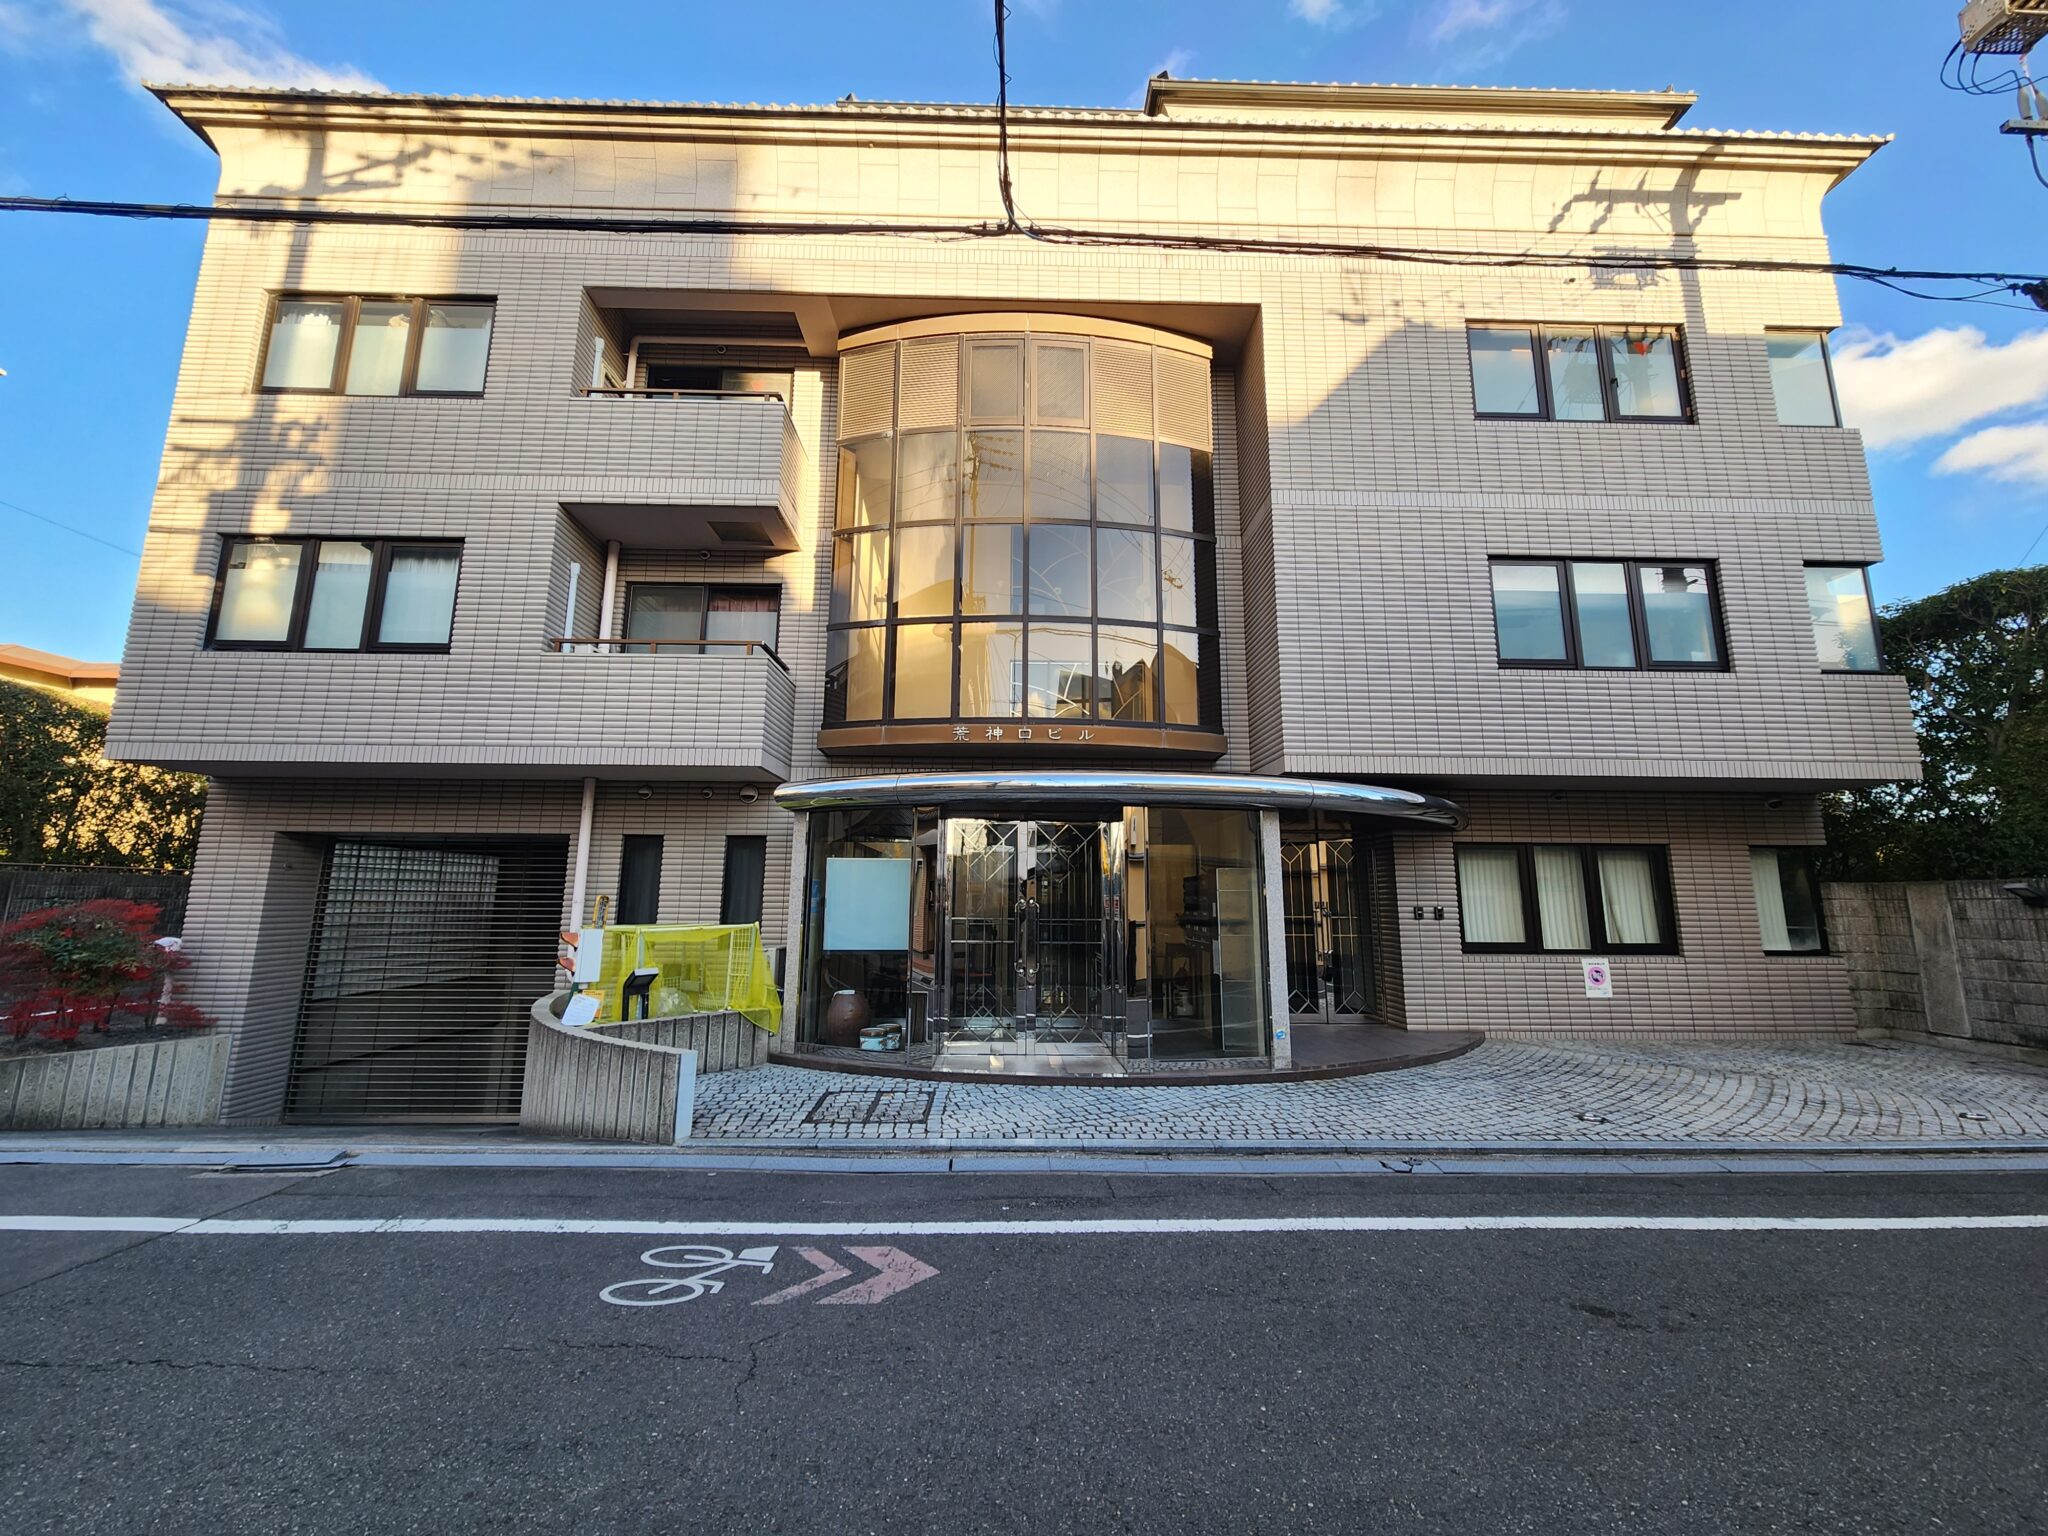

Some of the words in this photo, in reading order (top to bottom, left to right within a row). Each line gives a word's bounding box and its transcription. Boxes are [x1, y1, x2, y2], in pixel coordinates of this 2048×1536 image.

[952, 726, 1095, 741] 荒神口ビル
